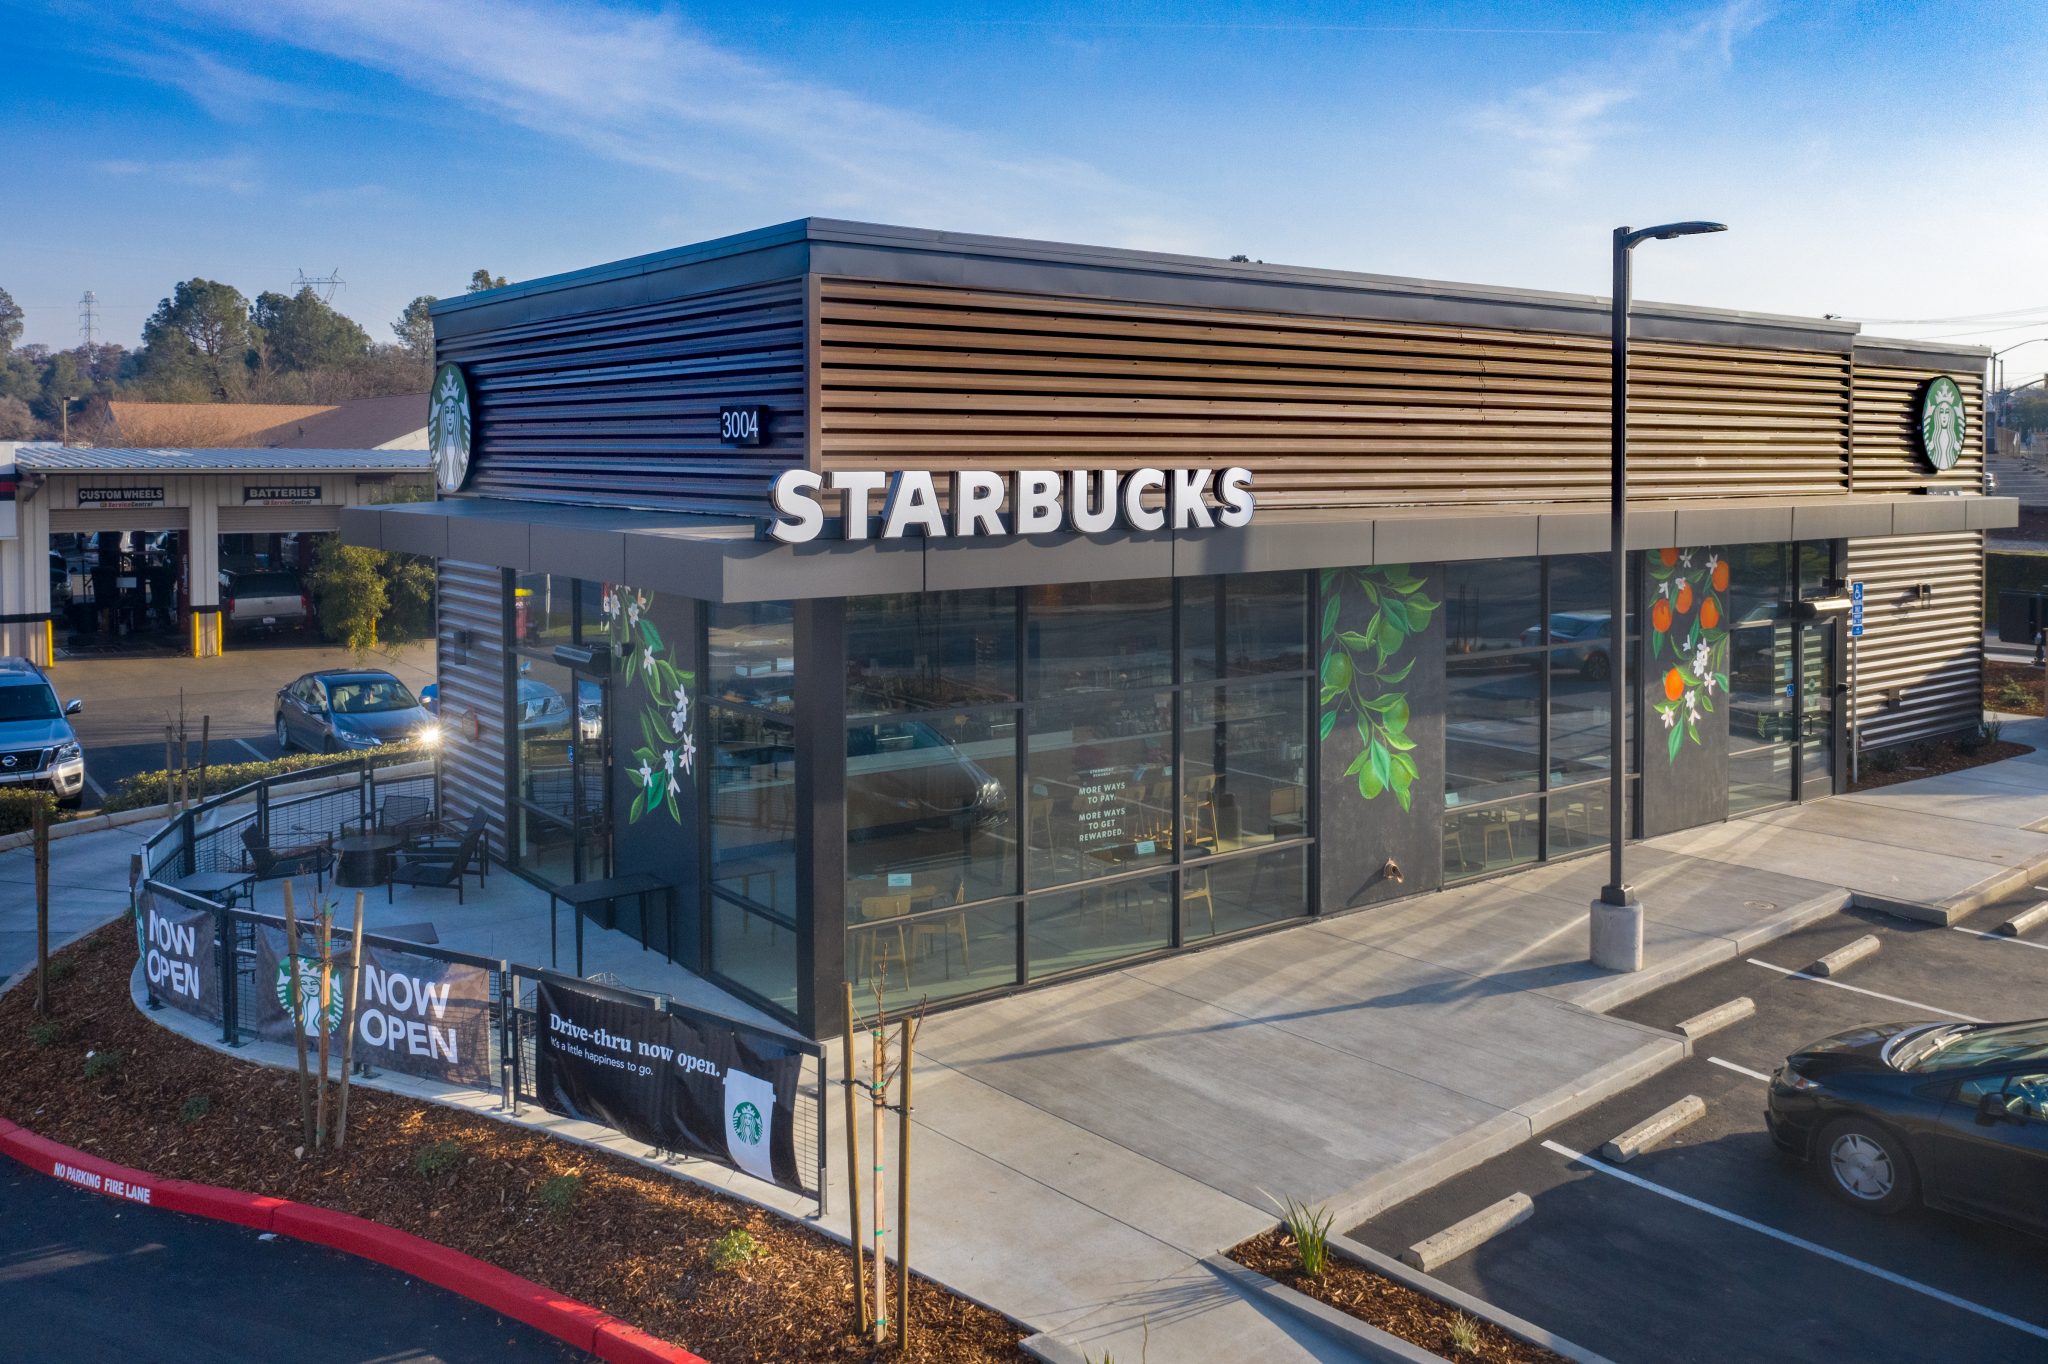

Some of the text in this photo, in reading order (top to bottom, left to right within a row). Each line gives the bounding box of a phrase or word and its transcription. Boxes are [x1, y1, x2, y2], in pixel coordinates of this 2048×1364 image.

[722, 411, 759, 438] 3004
[80, 489, 163, 500] CUSTOM WHEELS
[249, 488, 316, 498] BATTERIES
[768, 467, 1256, 543] STARBUCKS
[1078, 782, 1126, 796] MORE WAYS
[1087, 794, 1117, 804] TO PAY.
[1078, 807, 1126, 822] MORE WAYS
[1088, 819, 1116, 830] TO GET
[1079, 828, 1125, 842] REWARDED.
[149, 909, 195, 957] NOW
[147, 949, 200, 1000] OPEN
[364, 964, 451, 1019] NOW
[359, 1008, 459, 1064] OPEN
[550, 1013, 721, 1077] Drive-thru now open.
[567, 1042, 583, 1057] little
[584, 1048, 625, 1069] happiness
[627, 1061, 637, 1072] to
[638, 1064, 654, 1077] go.
[53, 1162, 151, 1204] NO PARKING FIRE LANE
